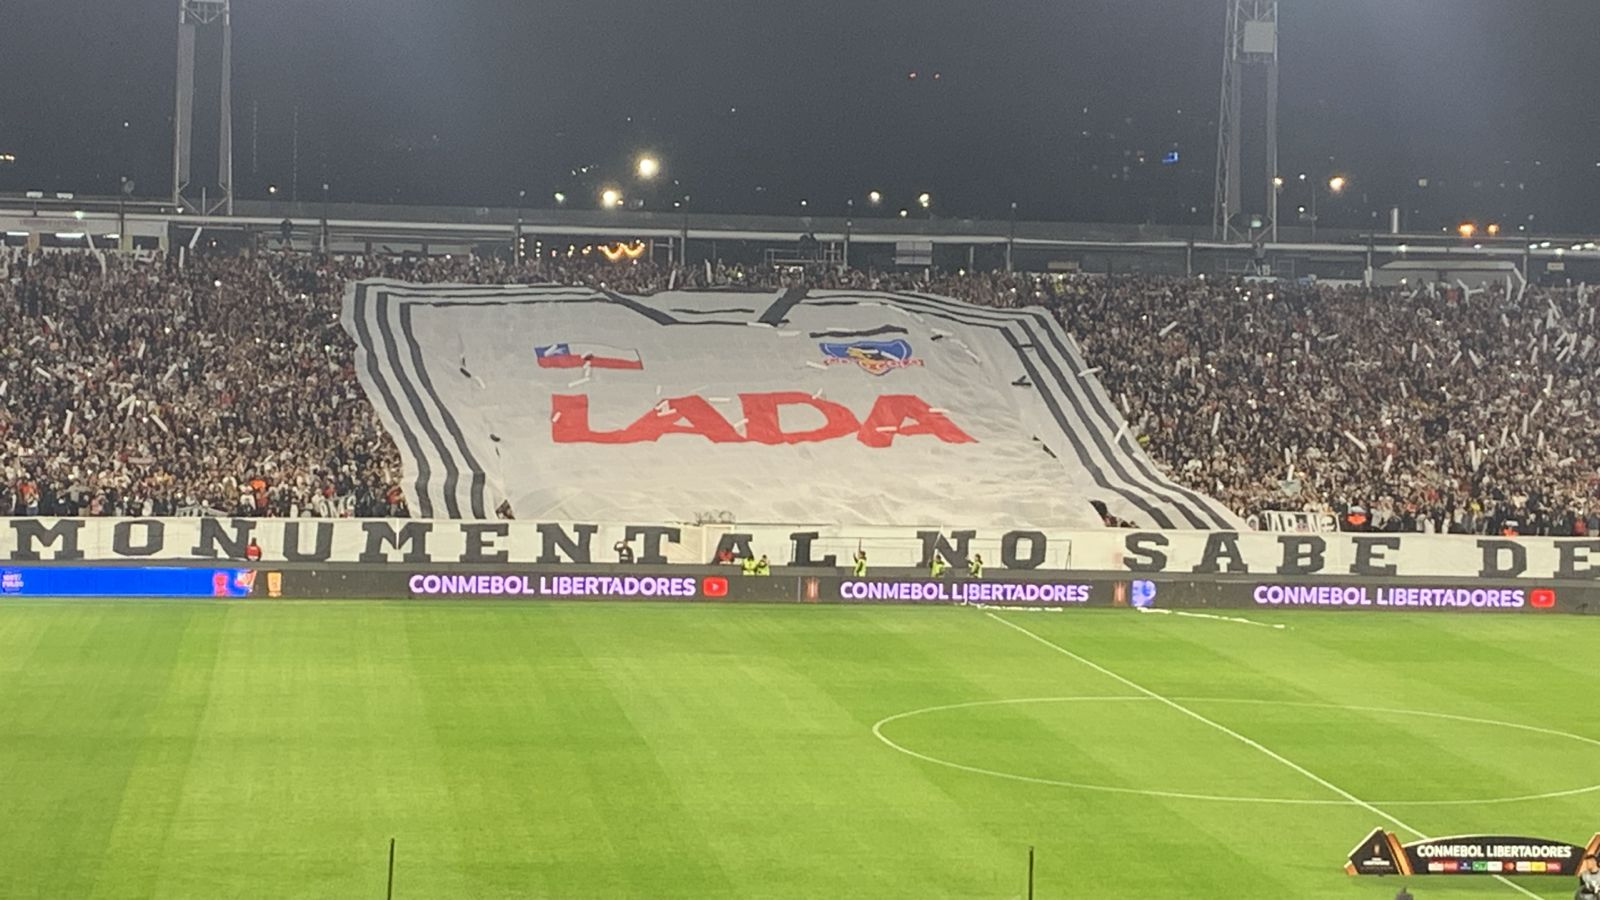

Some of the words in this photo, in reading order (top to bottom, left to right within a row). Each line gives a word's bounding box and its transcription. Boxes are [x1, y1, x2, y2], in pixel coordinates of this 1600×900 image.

[551, 392, 978, 447] LADA
[10, 519, 836, 568] MONUMENTAL
[916, 530, 1047, 569] NO
[1123, 531, 1401, 577] SABE
[1476, 539, 1600, 579] DE
[408, 574, 534, 595] CONMEBOL
[540, 576, 696, 597] LIBERTADORES
[840, 581, 949, 601] CONMEBOL
[952, 582, 1090, 603] LIBERTADORES
[1253, 585, 1371, 606] CONMEBOL
[1376, 587, 1525, 608] LIBERTADORES
[1416, 844, 1484, 858] CONMEBOL
[1486, 844, 1572, 859] LIBERTADORES
